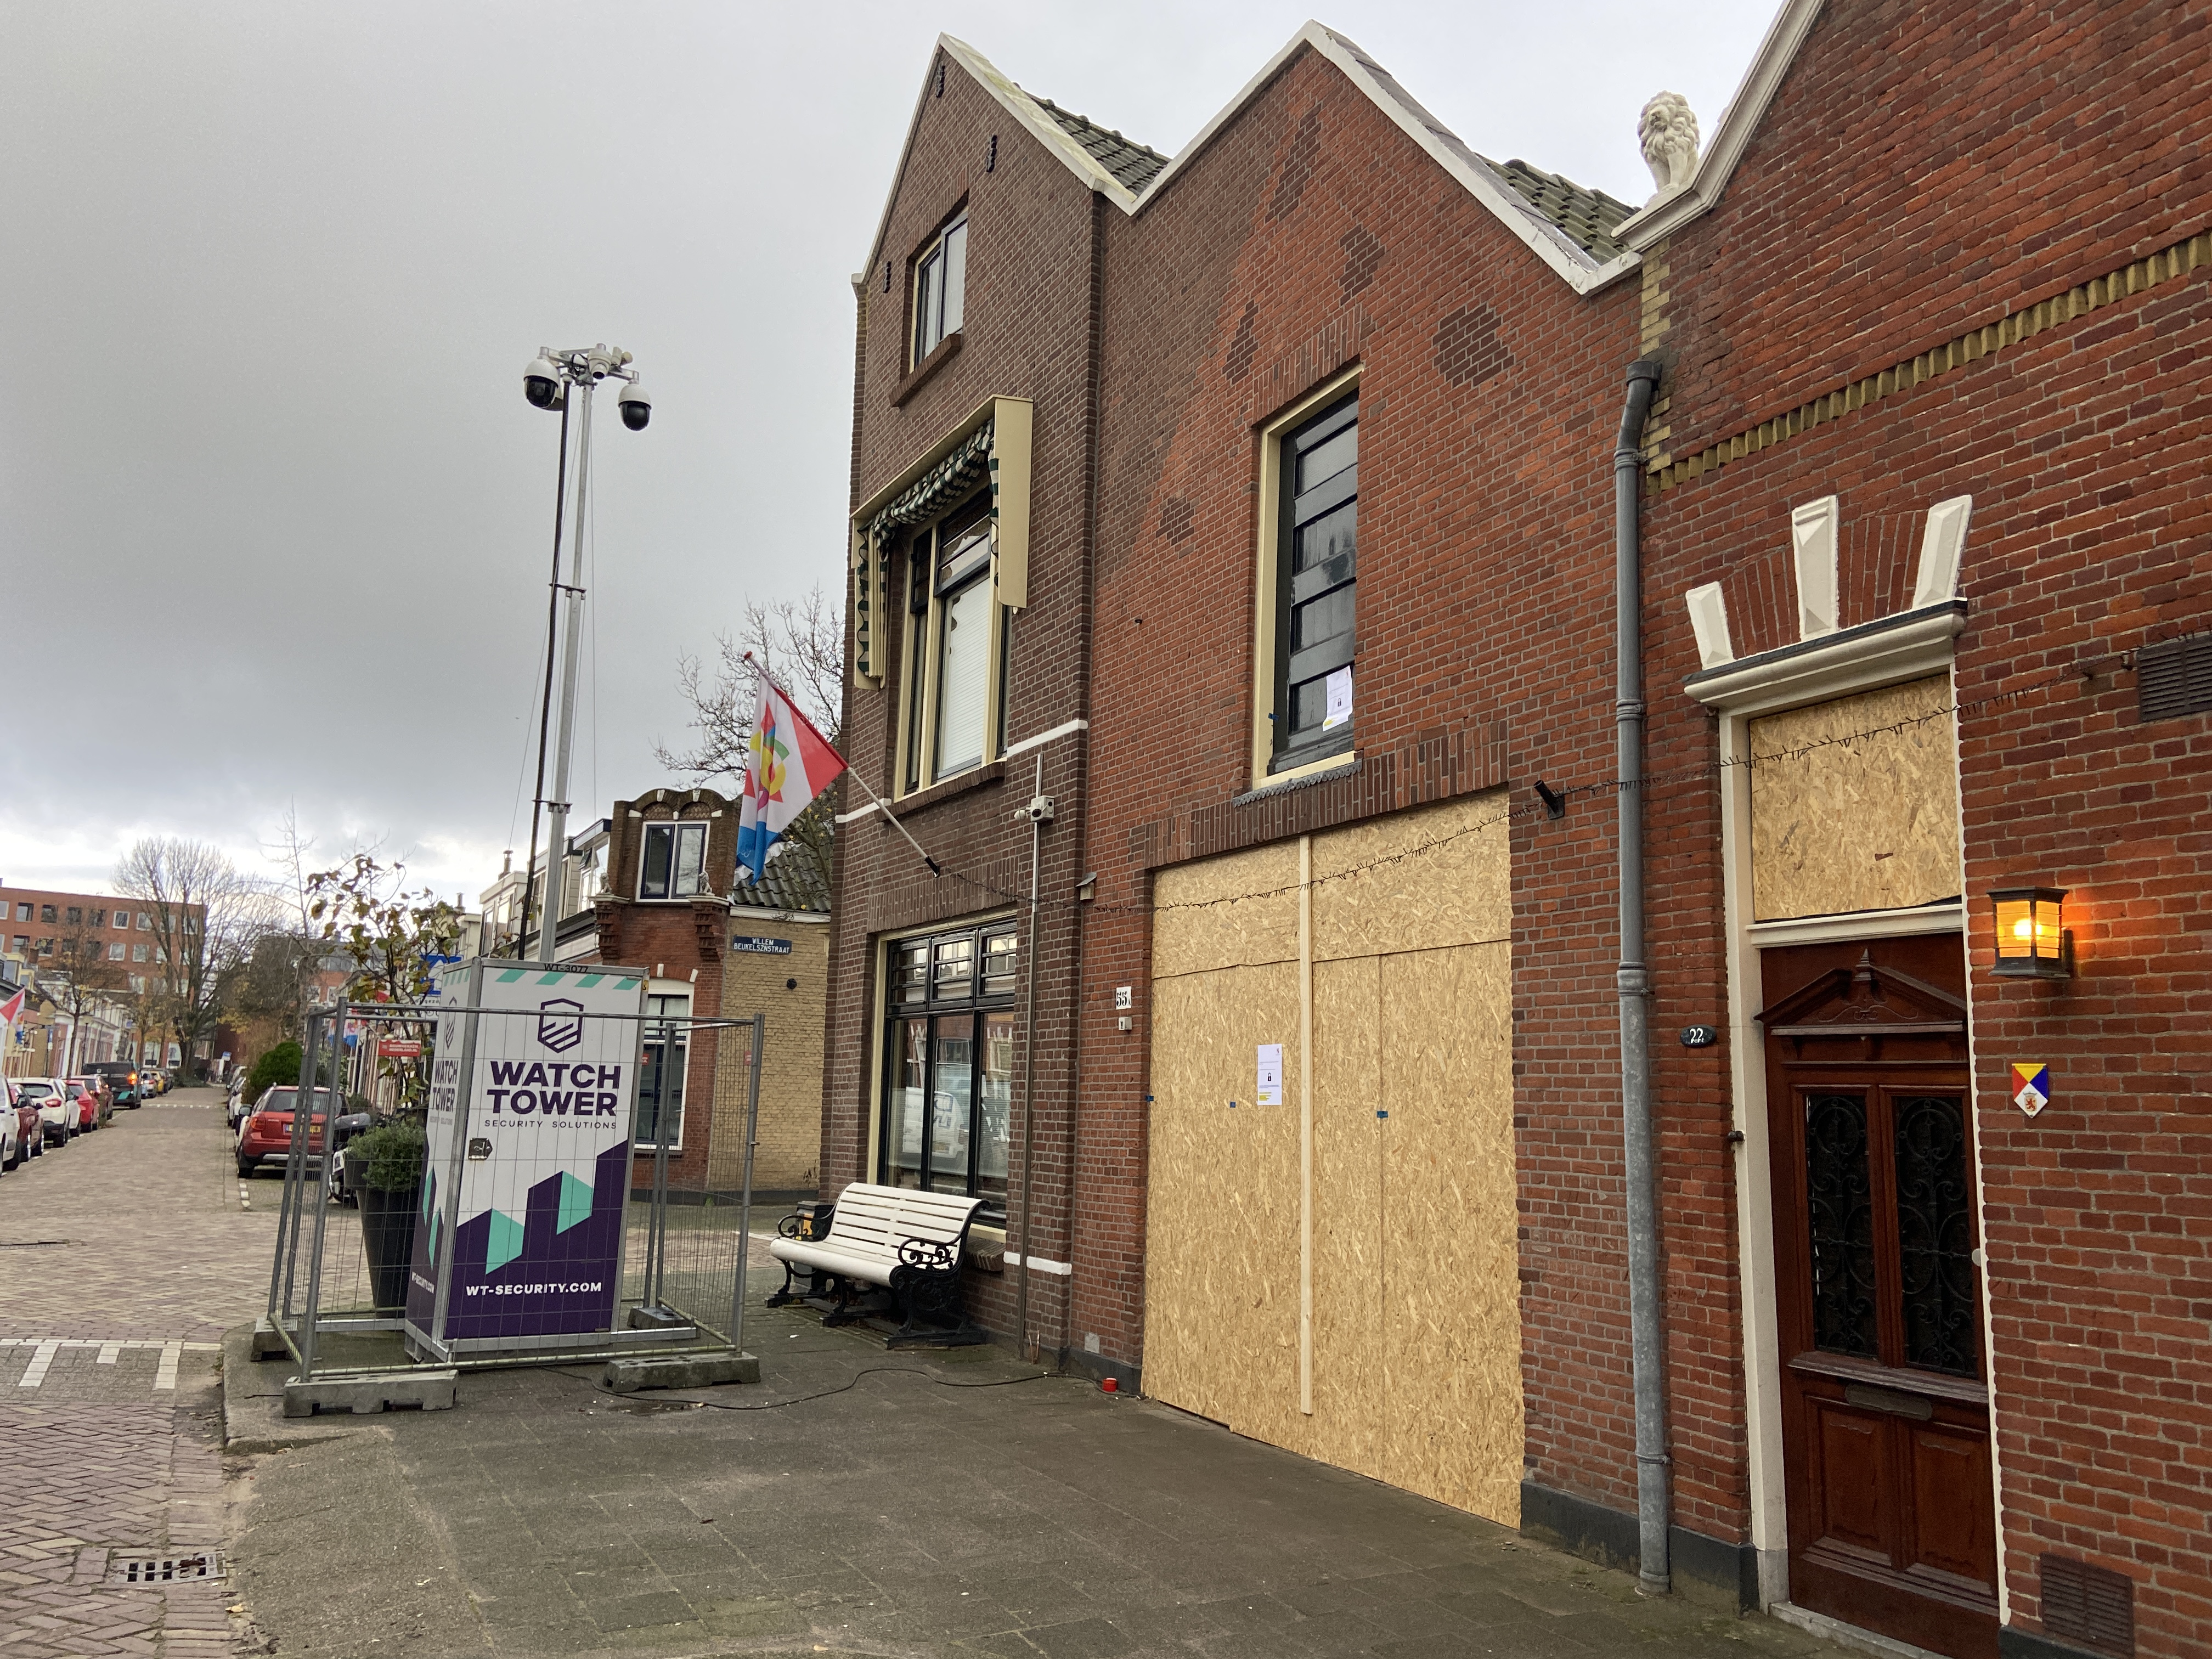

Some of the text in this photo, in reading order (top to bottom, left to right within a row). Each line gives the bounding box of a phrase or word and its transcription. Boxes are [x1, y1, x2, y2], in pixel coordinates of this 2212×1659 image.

[752, 937, 774, 945] WILLEM
[733, 943, 790, 954] BEUKELSZNSTRAAT
[544, 963, 589, 973] WT-3077
[1689, 1028, 1704, 1043] 22
[435, 1059, 459, 1085] WATCH
[489, 1060, 621, 1090] WATCH
[432, 1087, 455, 1113] TOWER
[487, 1089, 618, 1116] TOWER
[484, 1120, 617, 1130] SECURITY SOLUTIONS
[466, 1282, 602, 1296] WT-SECURITY.COM
